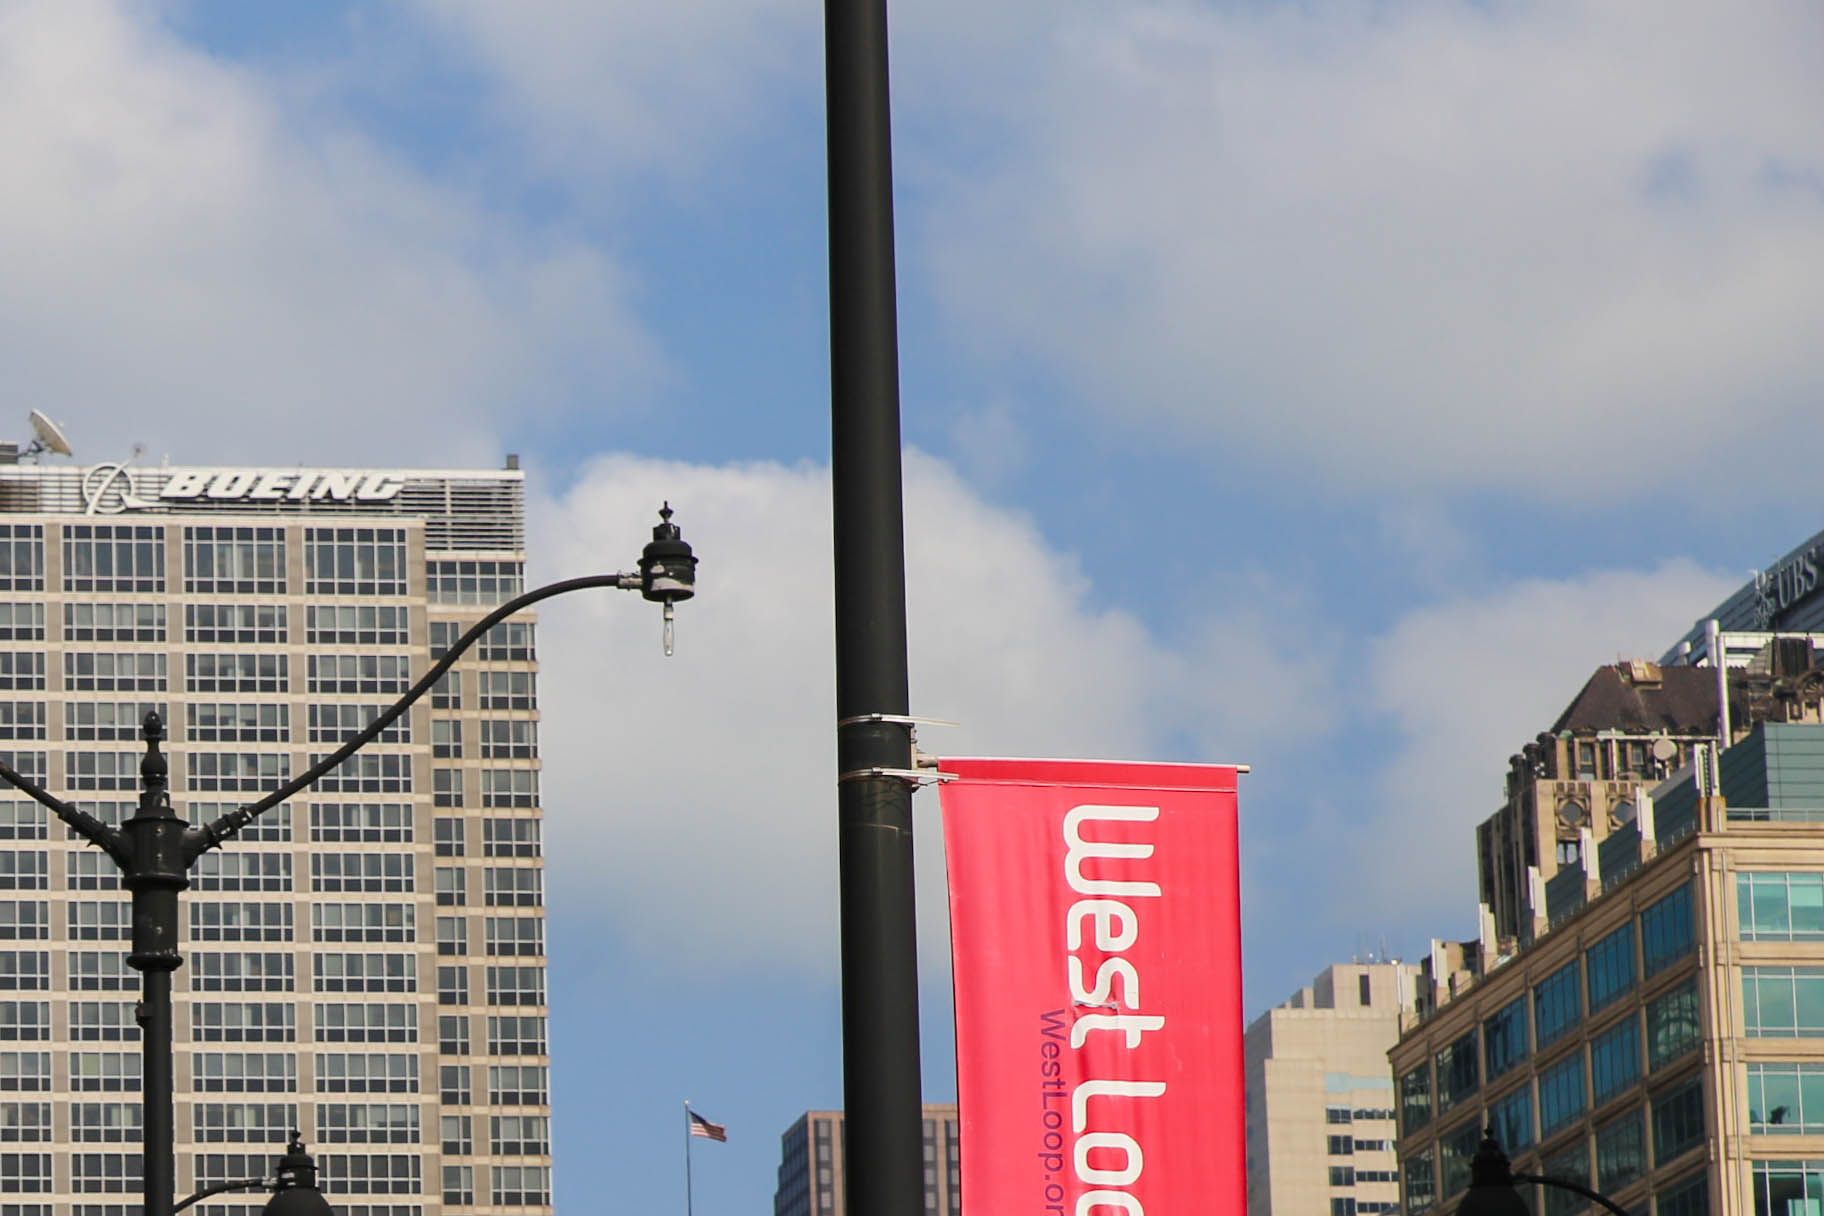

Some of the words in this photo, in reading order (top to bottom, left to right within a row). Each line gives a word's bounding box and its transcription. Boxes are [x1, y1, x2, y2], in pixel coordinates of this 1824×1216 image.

[159, 469, 408, 500] BOEING
[1778, 546, 1818, 609] UBS
[1063, 804, 1166, 1050] West
